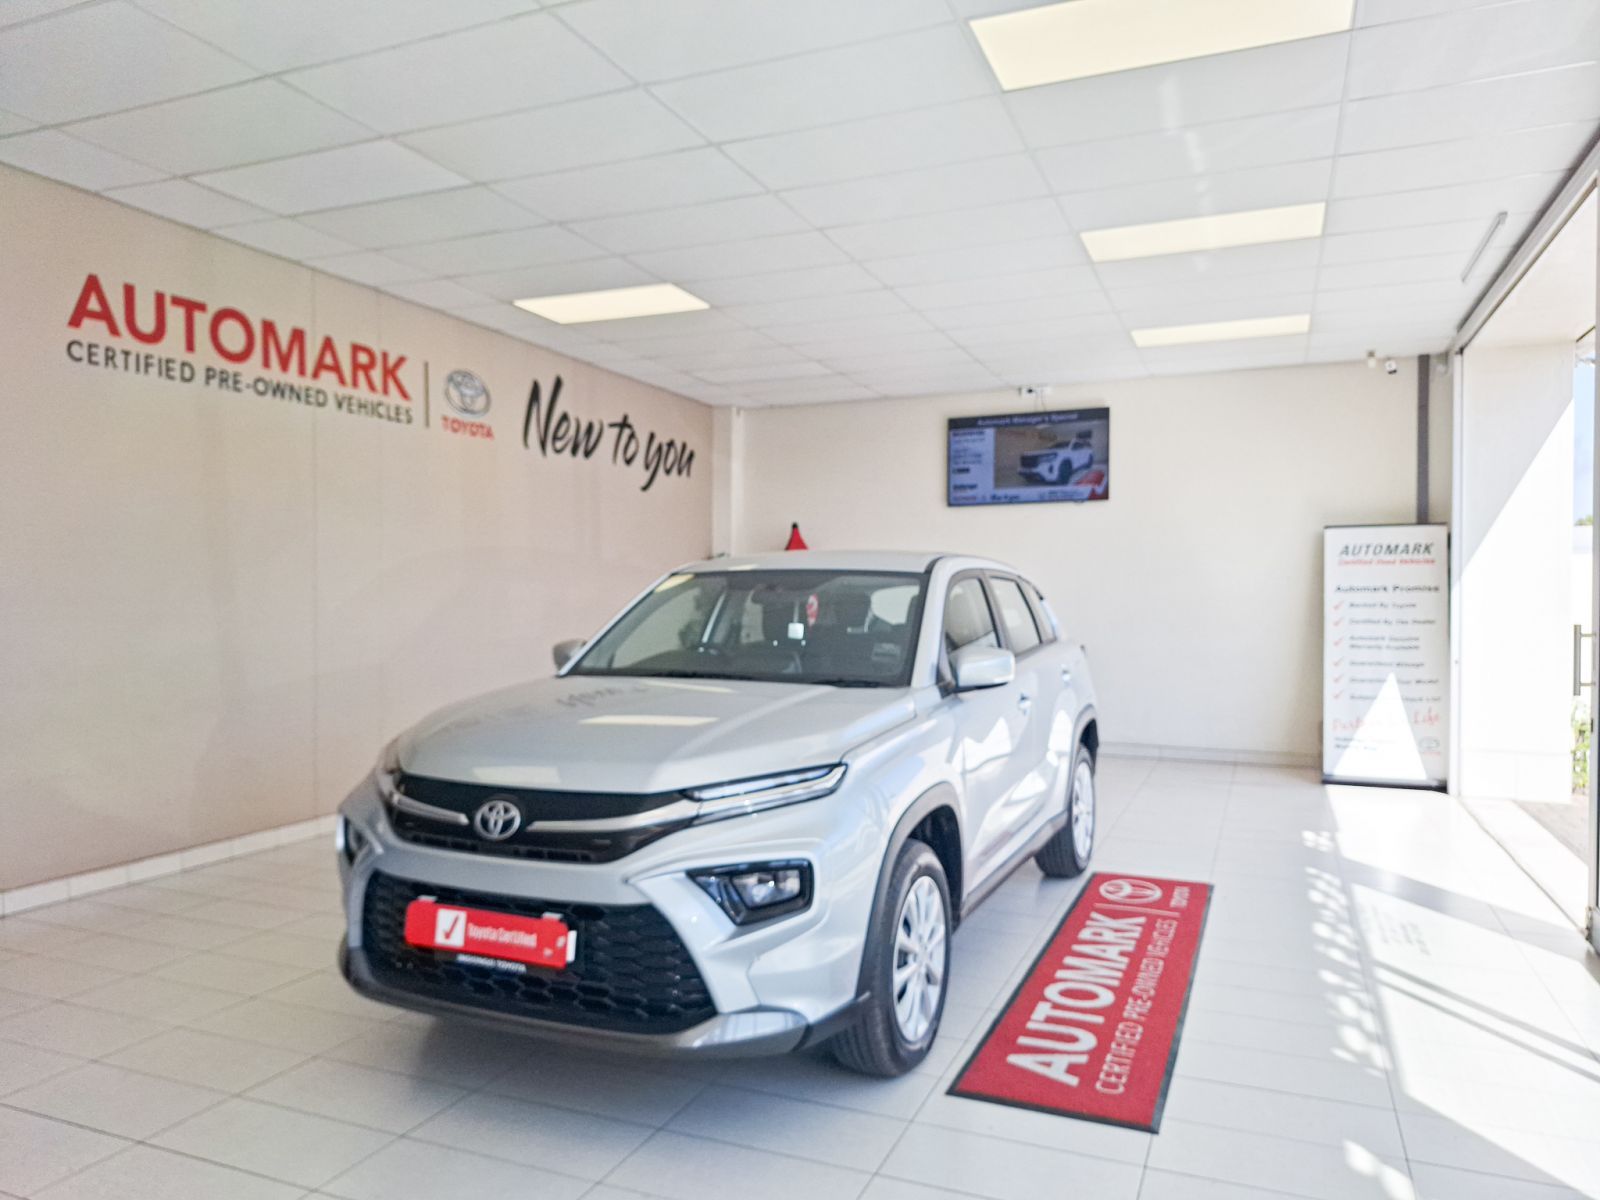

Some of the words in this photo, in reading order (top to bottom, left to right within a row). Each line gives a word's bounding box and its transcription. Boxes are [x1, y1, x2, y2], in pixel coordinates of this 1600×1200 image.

[66, 339, 196, 383] CERTIFIED
[204, 366, 328, 409] PRE-OWNED
[334, 392, 413, 425] VEHICLES
[67, 273, 412, 401] AUTOMARK
[441, 415, 495, 440] TOYOTA
[523, 374, 604, 460] New
[608, 413, 640, 466] to
[640, 431, 695, 492] you
[1339, 542, 1435, 556] AUTOMARK
[1006, 911, 1147, 1088] AUTOMARK
[1095, 1021, 1144, 1095] CERTIFIED
[1122, 956, 1165, 1021] PRE-OWNED
[1146, 918, 1178, 958] VEHICLES
